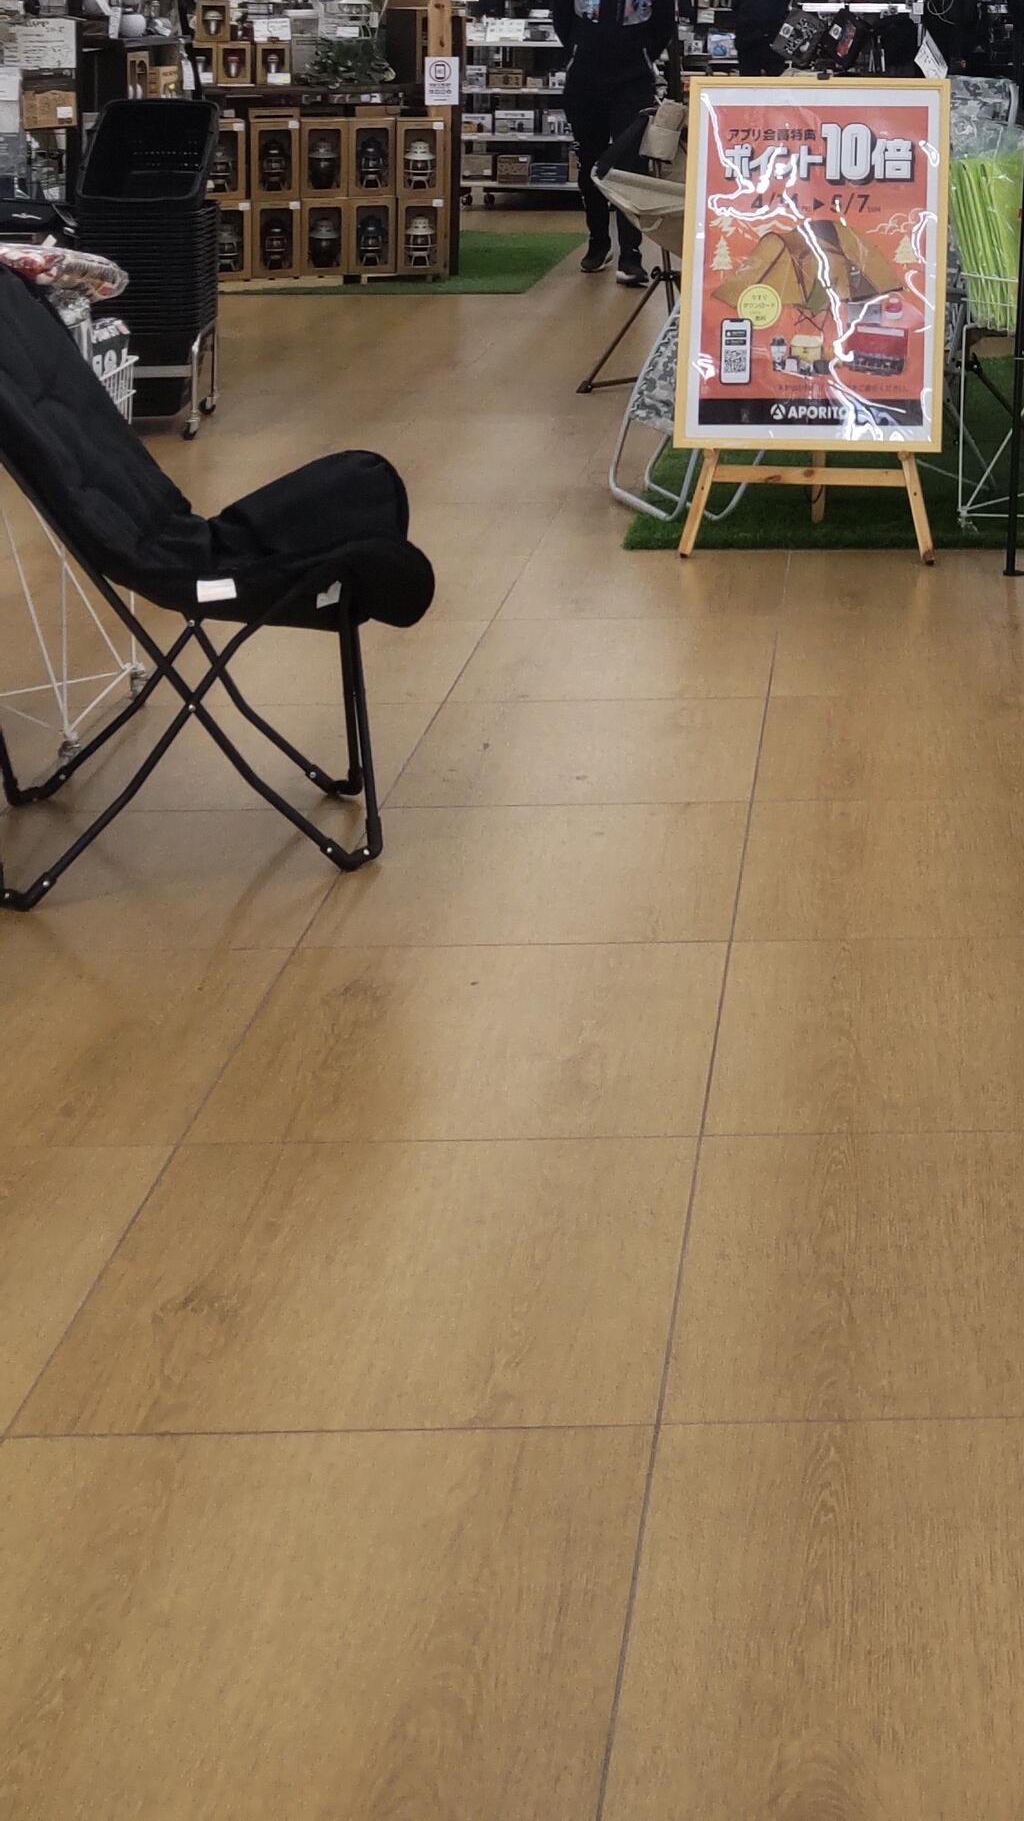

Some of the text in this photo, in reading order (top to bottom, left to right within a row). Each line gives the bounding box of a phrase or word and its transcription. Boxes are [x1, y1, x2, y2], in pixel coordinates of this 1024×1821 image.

[729, 128, 816, 142] アプリ会員特典
[830, 194, 870, 213] 5/7
